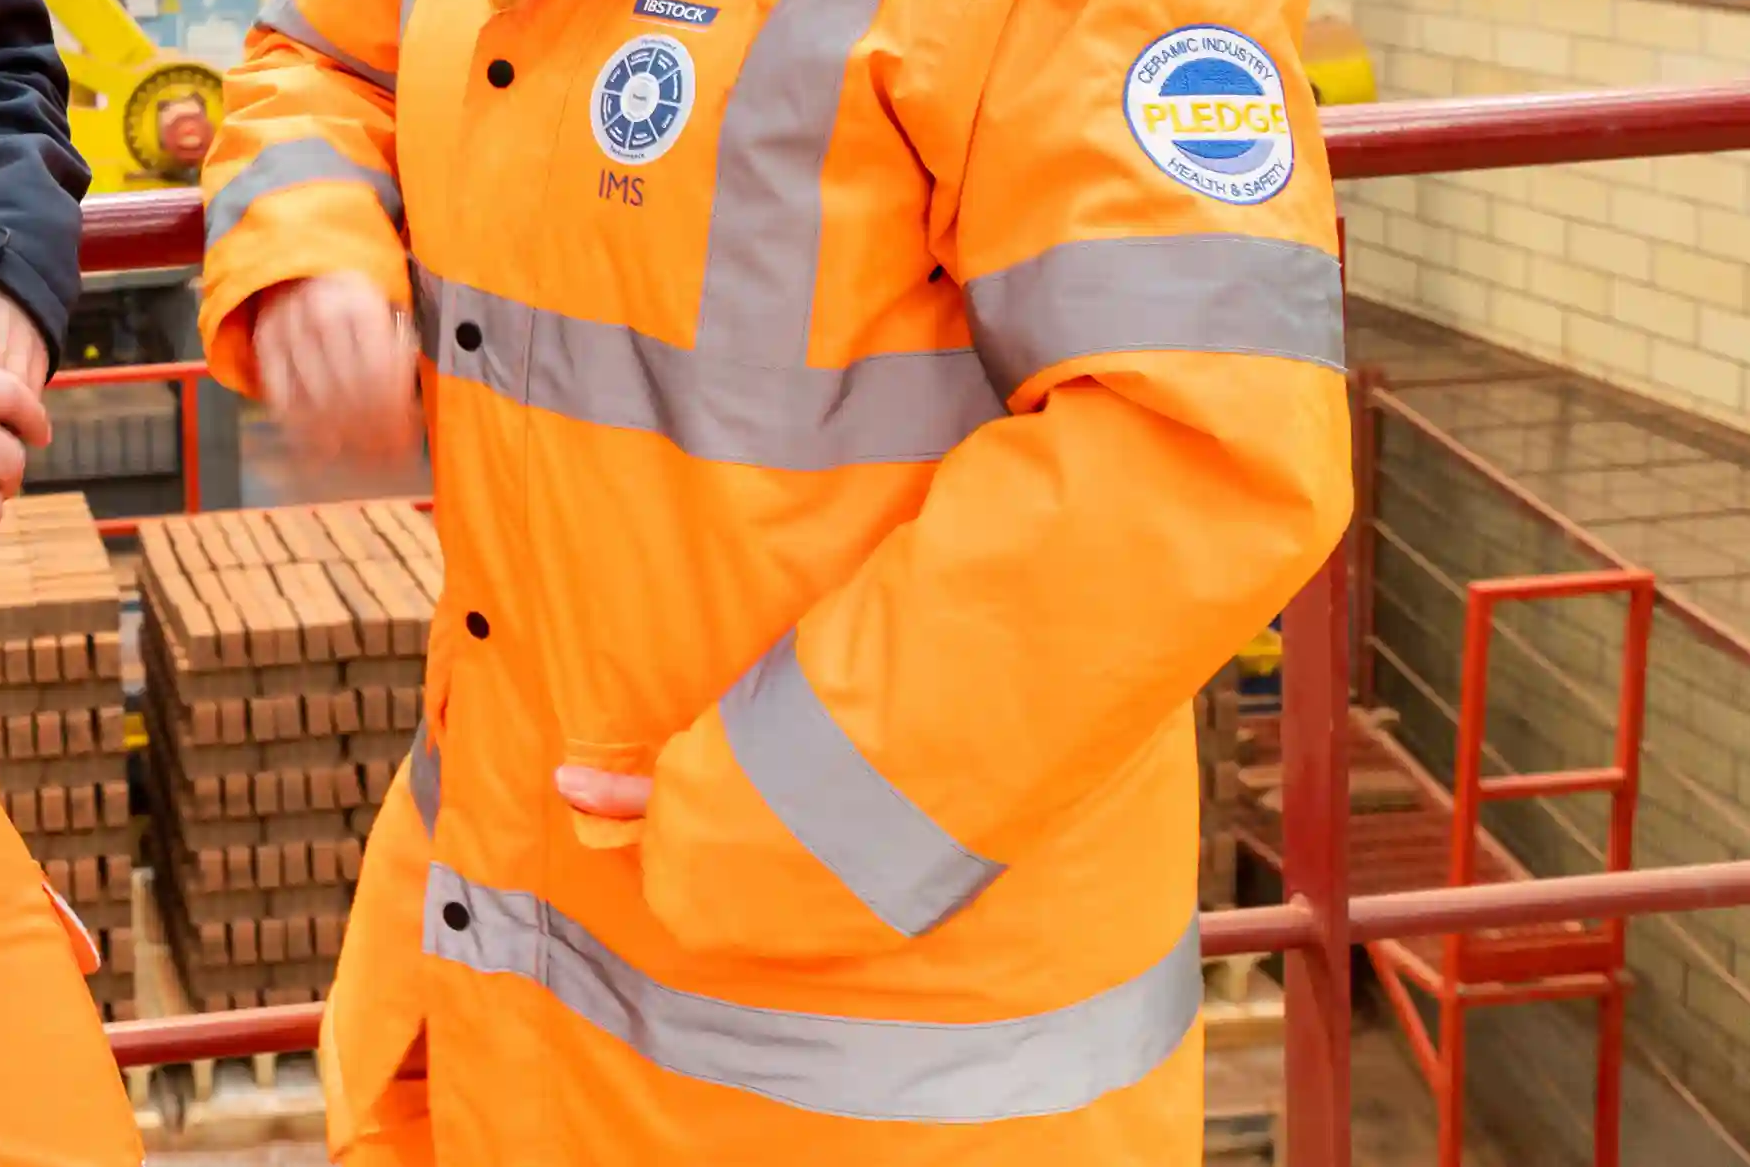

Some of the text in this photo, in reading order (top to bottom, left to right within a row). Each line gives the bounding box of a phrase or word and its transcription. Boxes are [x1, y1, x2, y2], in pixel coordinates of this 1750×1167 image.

[1137, 38, 1273, 84] CERAMIC INDUSTRY
[1143, 102, 1287, 133] PLEDGE
[598, 169, 645, 206] IMS
[1168, 157, 1286, 197] HEALTH & SAFETY
